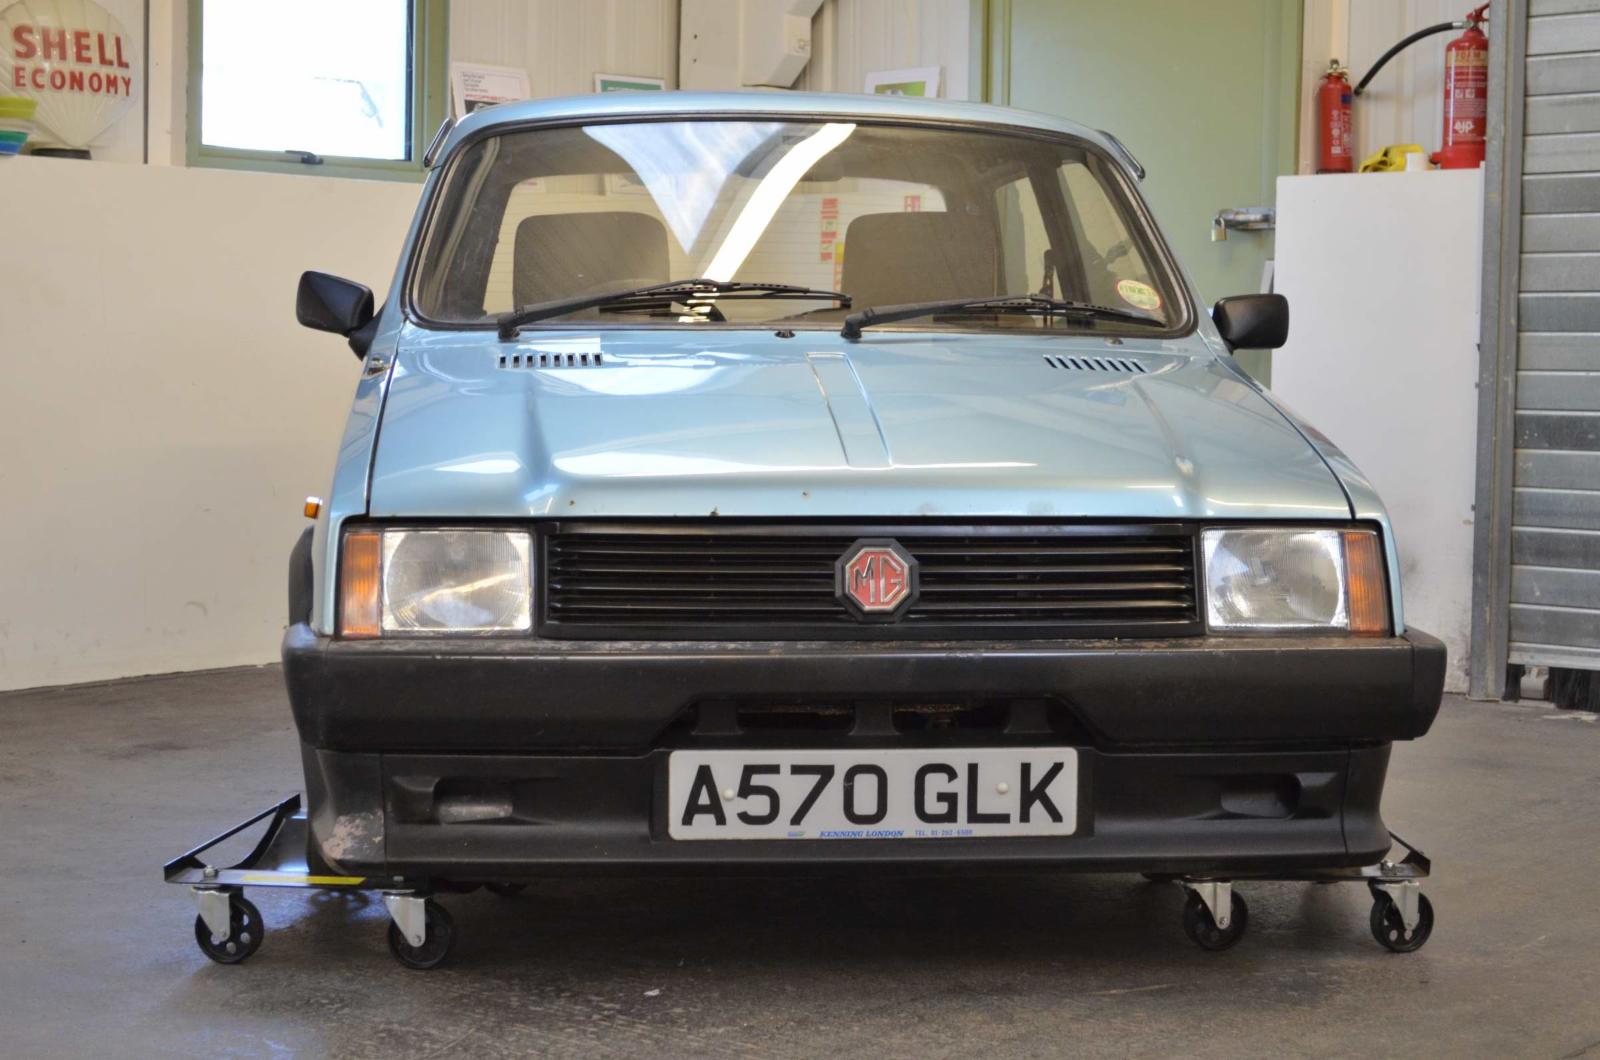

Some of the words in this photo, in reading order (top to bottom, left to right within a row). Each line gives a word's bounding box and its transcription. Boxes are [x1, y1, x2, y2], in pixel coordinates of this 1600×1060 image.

[13, 24, 130, 69] SHELL
[13, 66, 131, 97] ECONOMY
[853, 555, 902, 604] MG
[681, 763, 889, 827] A570
[913, 761, 1065, 825] GLK
[865, 829, 905, 838] LONDON
